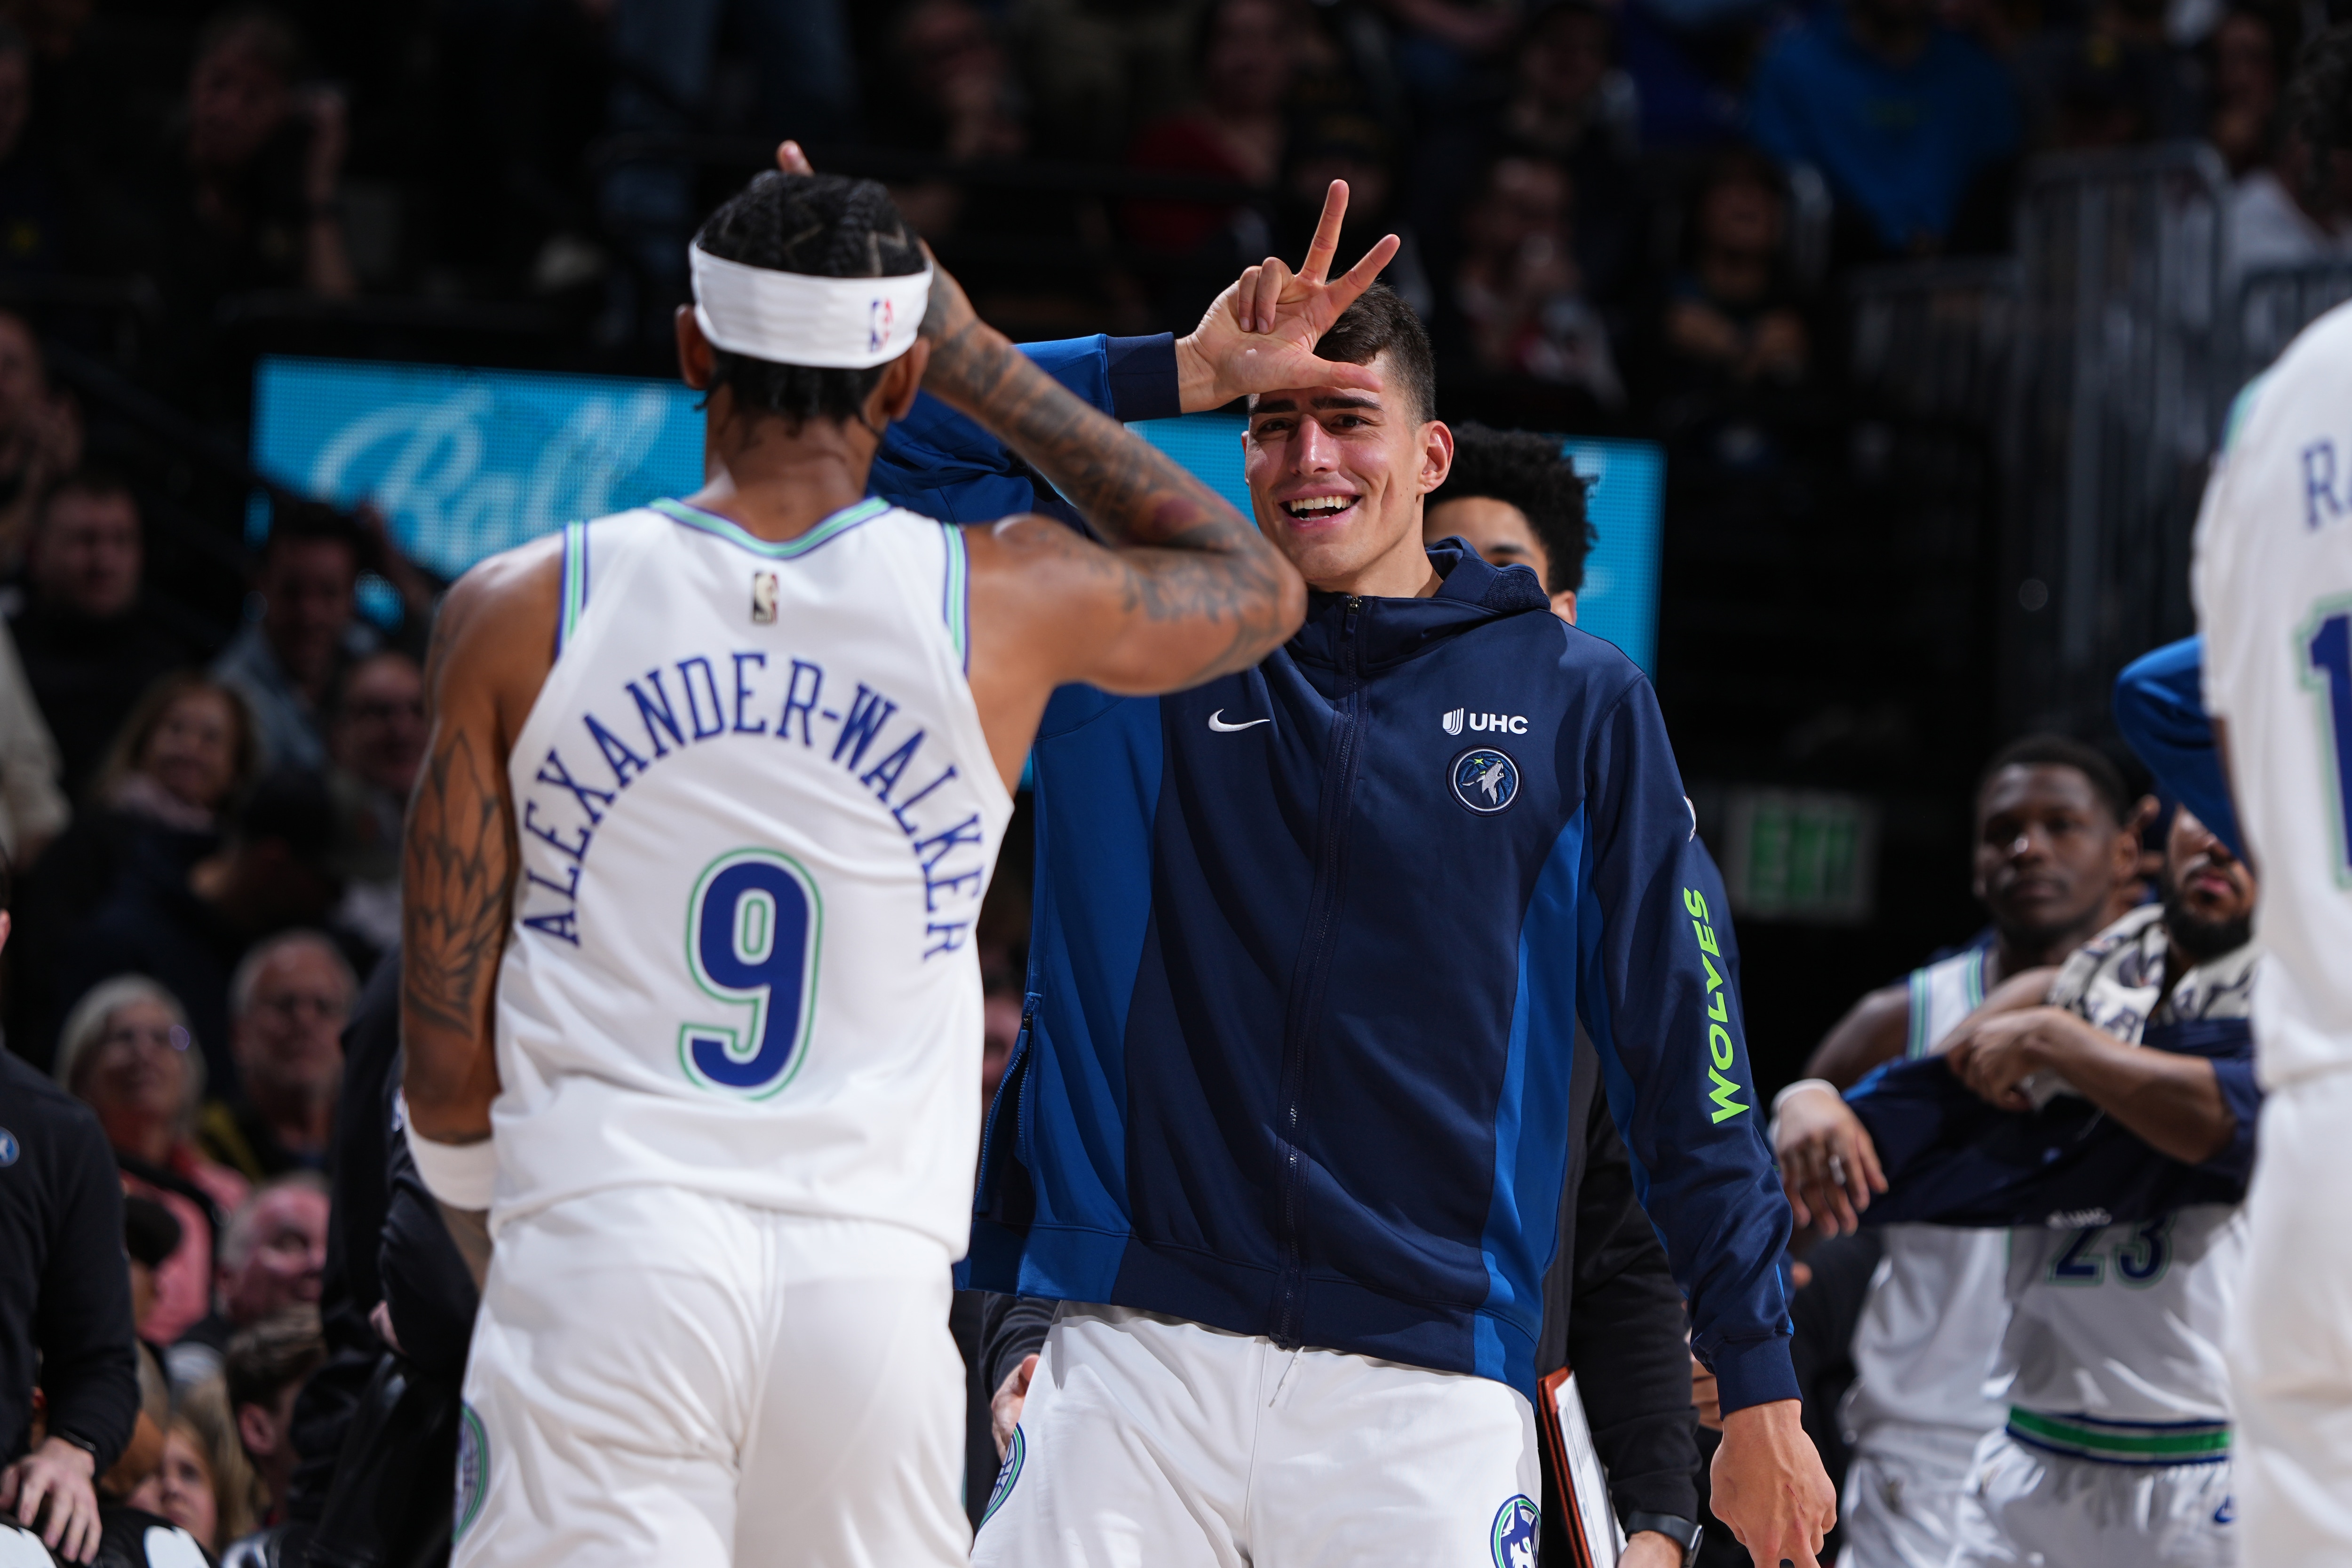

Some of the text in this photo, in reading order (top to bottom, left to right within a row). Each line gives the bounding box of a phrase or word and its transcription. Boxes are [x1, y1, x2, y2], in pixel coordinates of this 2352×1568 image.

[522, 651, 986, 961] ALEXANDER-WALKER
[1470, 713, 1529, 735] UHC
[678, 847, 823, 1101] 9
[1683, 887, 1750, 1125] WOLVES
